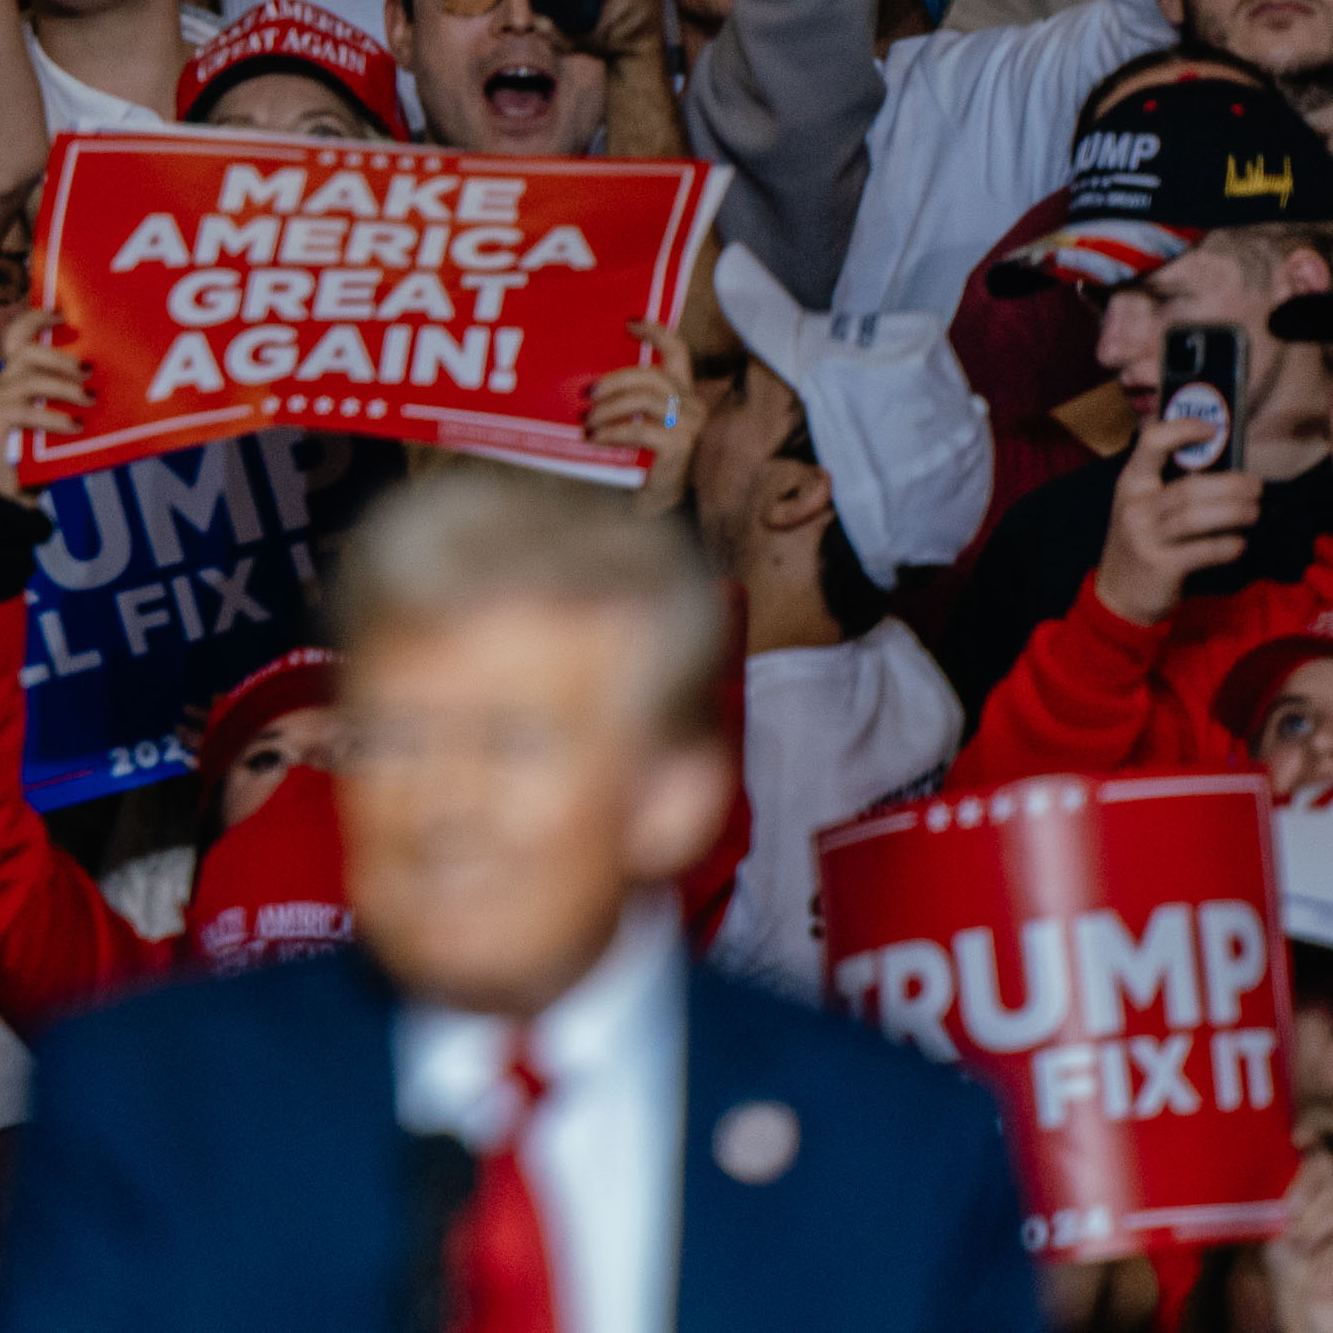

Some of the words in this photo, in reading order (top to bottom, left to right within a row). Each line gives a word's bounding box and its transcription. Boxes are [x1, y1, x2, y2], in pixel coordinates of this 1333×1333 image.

[1073, 130, 1162, 172] UMP
[217, 164, 526, 224] MAKE
[110, 213, 596, 272] AMERICA
[165, 269, 531, 327] GREAT
[145, 323, 525, 403] AGAIN!
[115, 567, 273, 658] FIX
[832, 899, 1269, 1064] TRUMP
[1034, 1032, 1201, 1130] FIX
[1210, 1027, 1275, 1112] IT
[1020, 1205, 1113, 1253] 024
